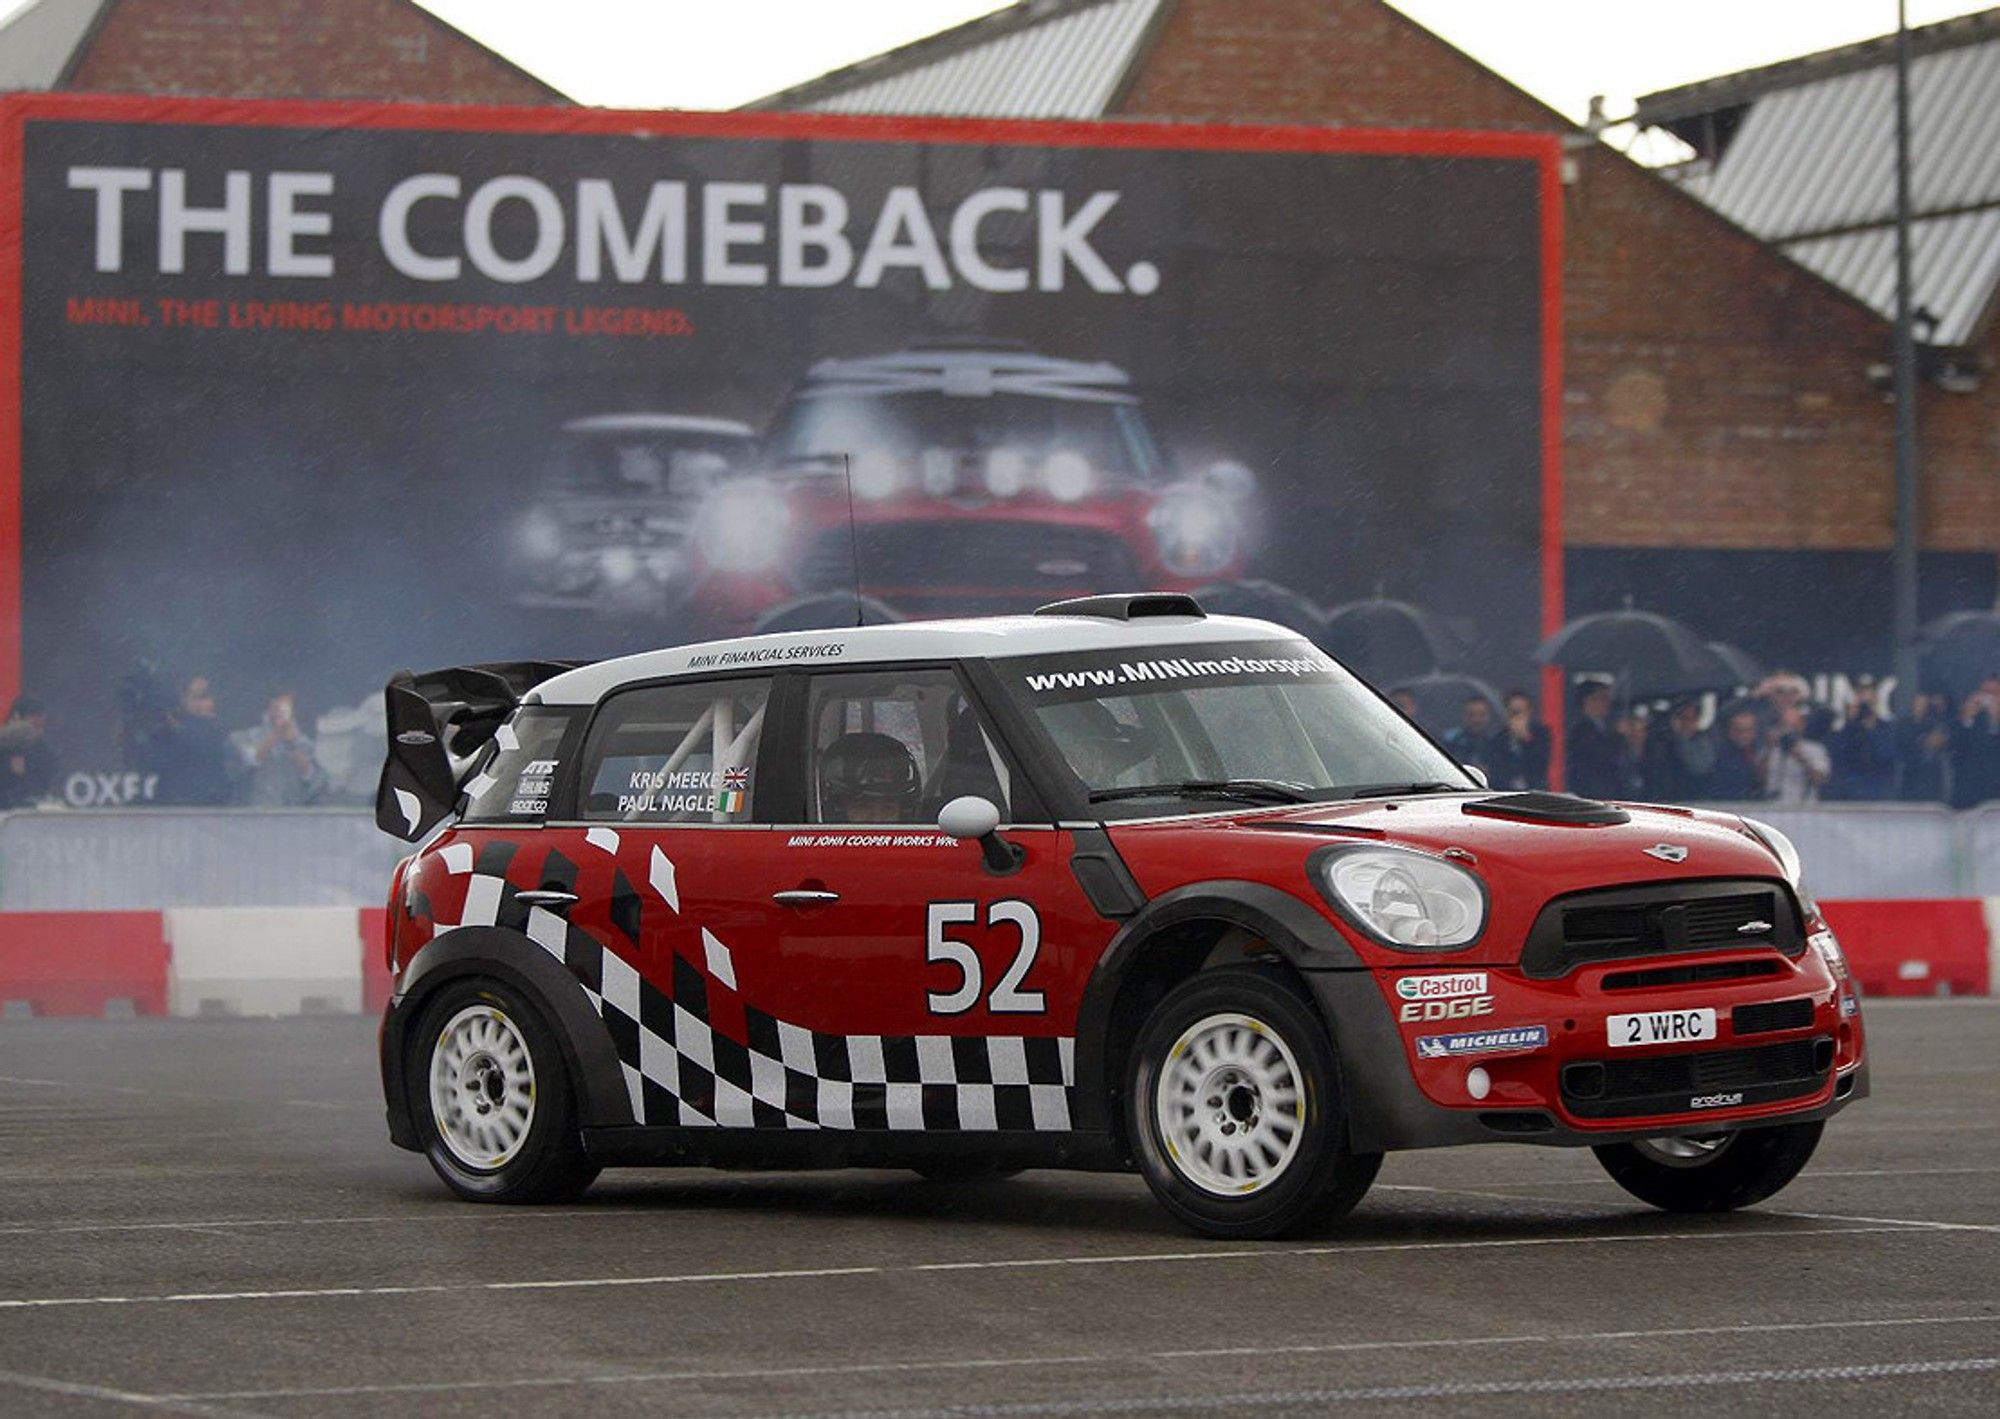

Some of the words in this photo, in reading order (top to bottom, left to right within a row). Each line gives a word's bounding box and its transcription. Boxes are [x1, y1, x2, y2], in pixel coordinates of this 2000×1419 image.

[67, 166, 334, 277] THE
[379, 172, 1160, 295] COMEBACK.
[66, 298, 150, 327] MINI.
[159, 300, 220, 329] THE
[227, 301, 335, 332] LIVING
[342, 302, 554, 334] MOTORSPORT
[566, 306, 695, 337] LEGEND.
[687, 655, 717, 669] MINI
[719, 648, 784, 664] FINANCIAL
[785, 644, 845, 659] SERVICES
[629, 771, 665, 789] KRIS
[667, 771, 721, 789] MEEKE
[617, 795, 658, 812] PAUL
[661, 795, 716, 812] NAGLE
[788, 836, 814, 847] MINI
[814, 836, 846, 847] JOHN
[847, 836, 892, 847] COOPER
[892, 836, 934, 847] WORKS
[927, 899, 1046, 1014] 52
[1420, 976, 1483, 996] Castrol
[1400, 995, 1496, 1023] EDGE
[1449, 1030, 1541, 1049] MICHELIN
[1627, 1017, 1642, 1042] 2
[1650, 1012, 1702, 1041] WRC
